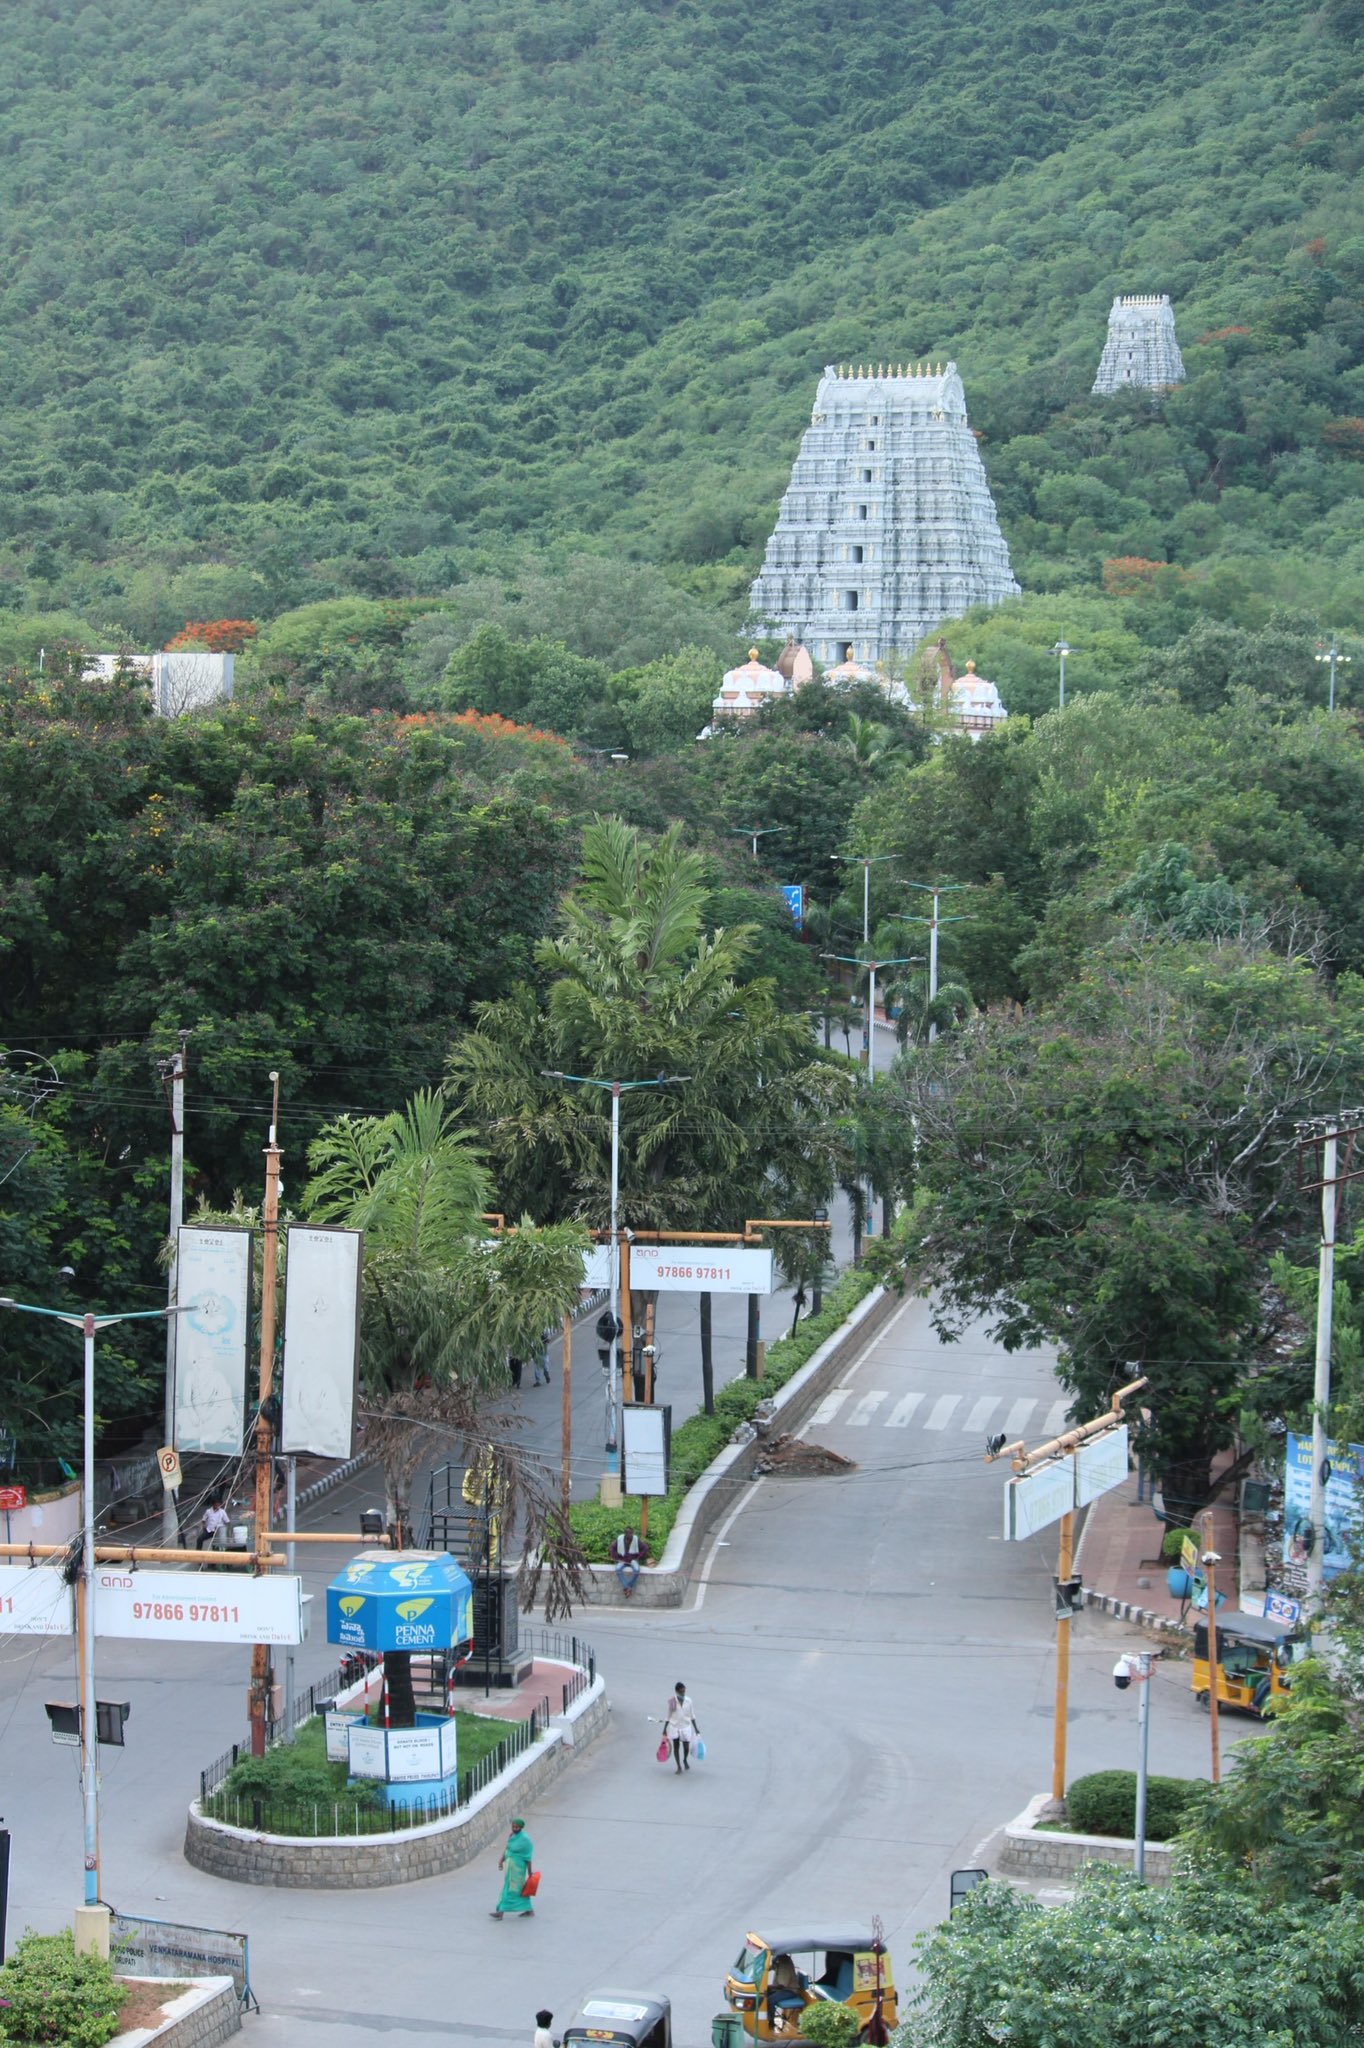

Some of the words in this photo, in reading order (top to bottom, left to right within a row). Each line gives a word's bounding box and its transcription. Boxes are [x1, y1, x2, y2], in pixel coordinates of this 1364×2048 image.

[657, 1266, 693, 1279] 97866
[696, 1267, 730, 1280] 97811
[133, 1602, 184, 1620] 97866
[189, 1604, 239, 1623] 97811
[395, 1624, 435, 1637] PENNA
[395, 1635, 435, 1645] CEMENT
[149, 1945, 206, 1962] VENKATARAMANA
[207, 1955, 240, 1968] HOSPITAL
